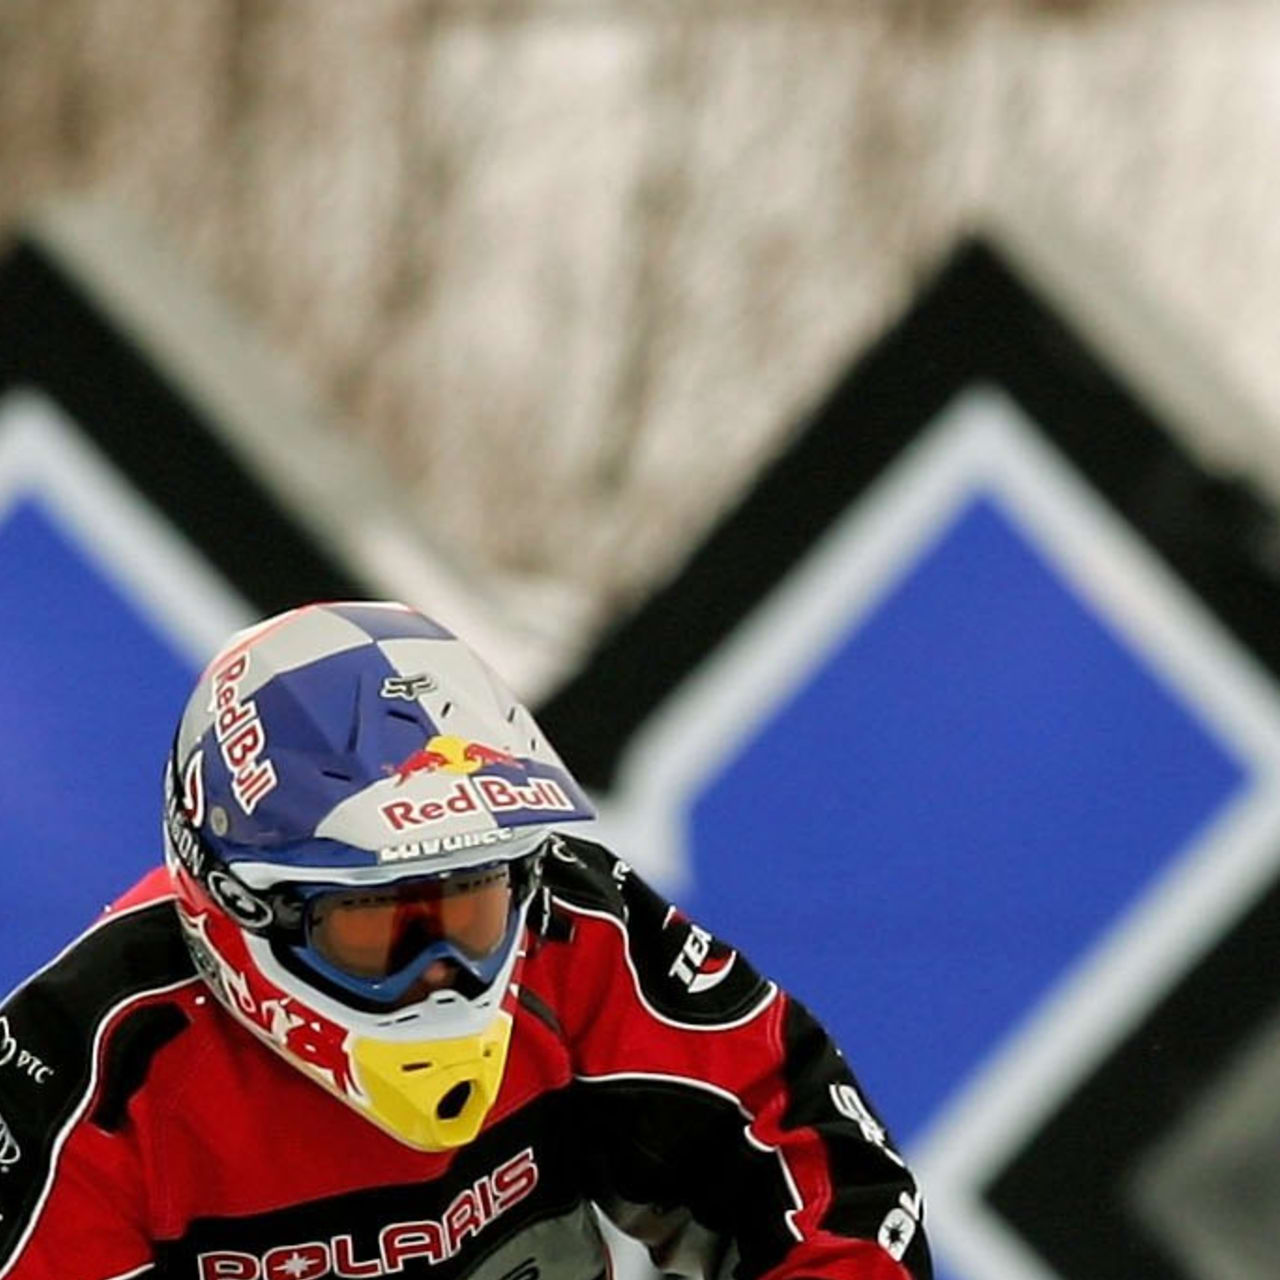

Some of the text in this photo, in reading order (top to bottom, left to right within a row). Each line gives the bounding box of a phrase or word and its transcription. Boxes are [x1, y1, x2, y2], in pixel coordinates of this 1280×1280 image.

[214, 652, 277, 815] Red Bull
[381, 776, 575, 831] Red Bull
